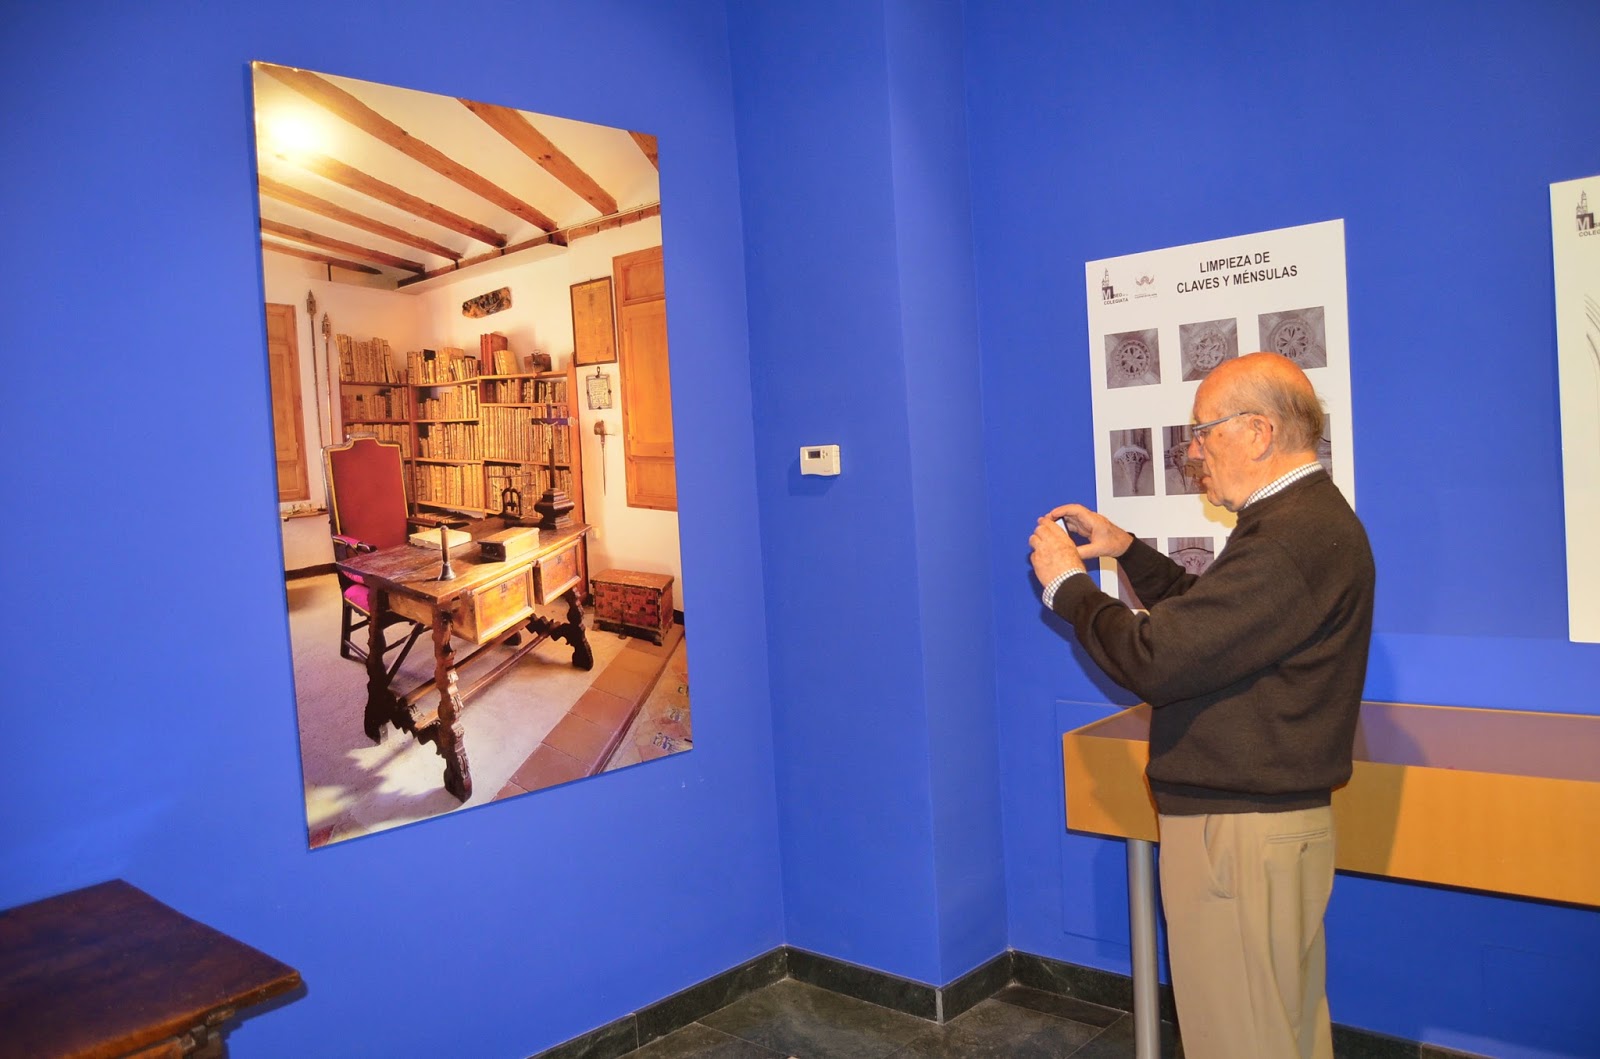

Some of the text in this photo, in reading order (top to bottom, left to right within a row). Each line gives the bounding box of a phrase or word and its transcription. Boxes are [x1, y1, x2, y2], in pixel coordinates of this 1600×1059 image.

[1199, 251, 1271, 273] LIMPIEZA DE
[1176, 265, 1298, 294] CLAVES Y MÉNSULAS
